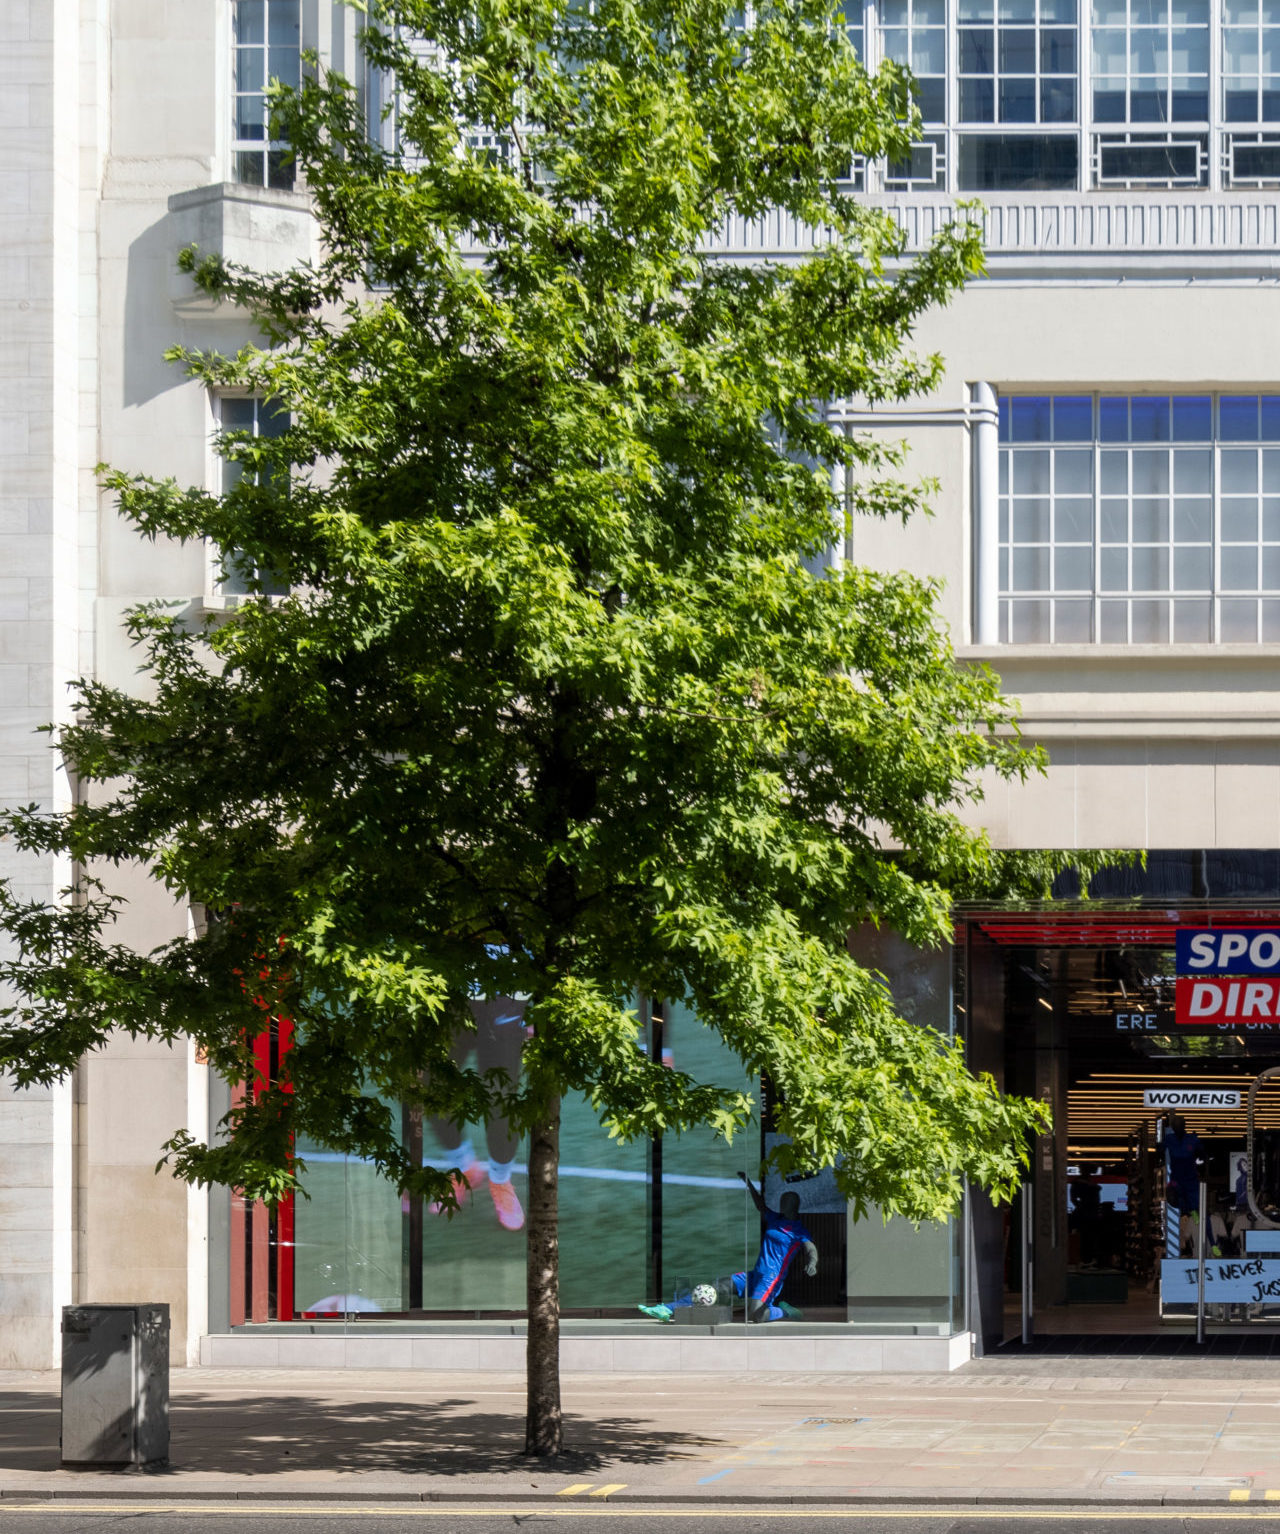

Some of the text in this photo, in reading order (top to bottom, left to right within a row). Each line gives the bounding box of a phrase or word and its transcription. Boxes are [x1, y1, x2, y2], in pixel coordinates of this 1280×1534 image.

[1148, 1093, 1237, 1105] WOMENS
[1185, 1259, 1266, 1285] ITS NEVER
